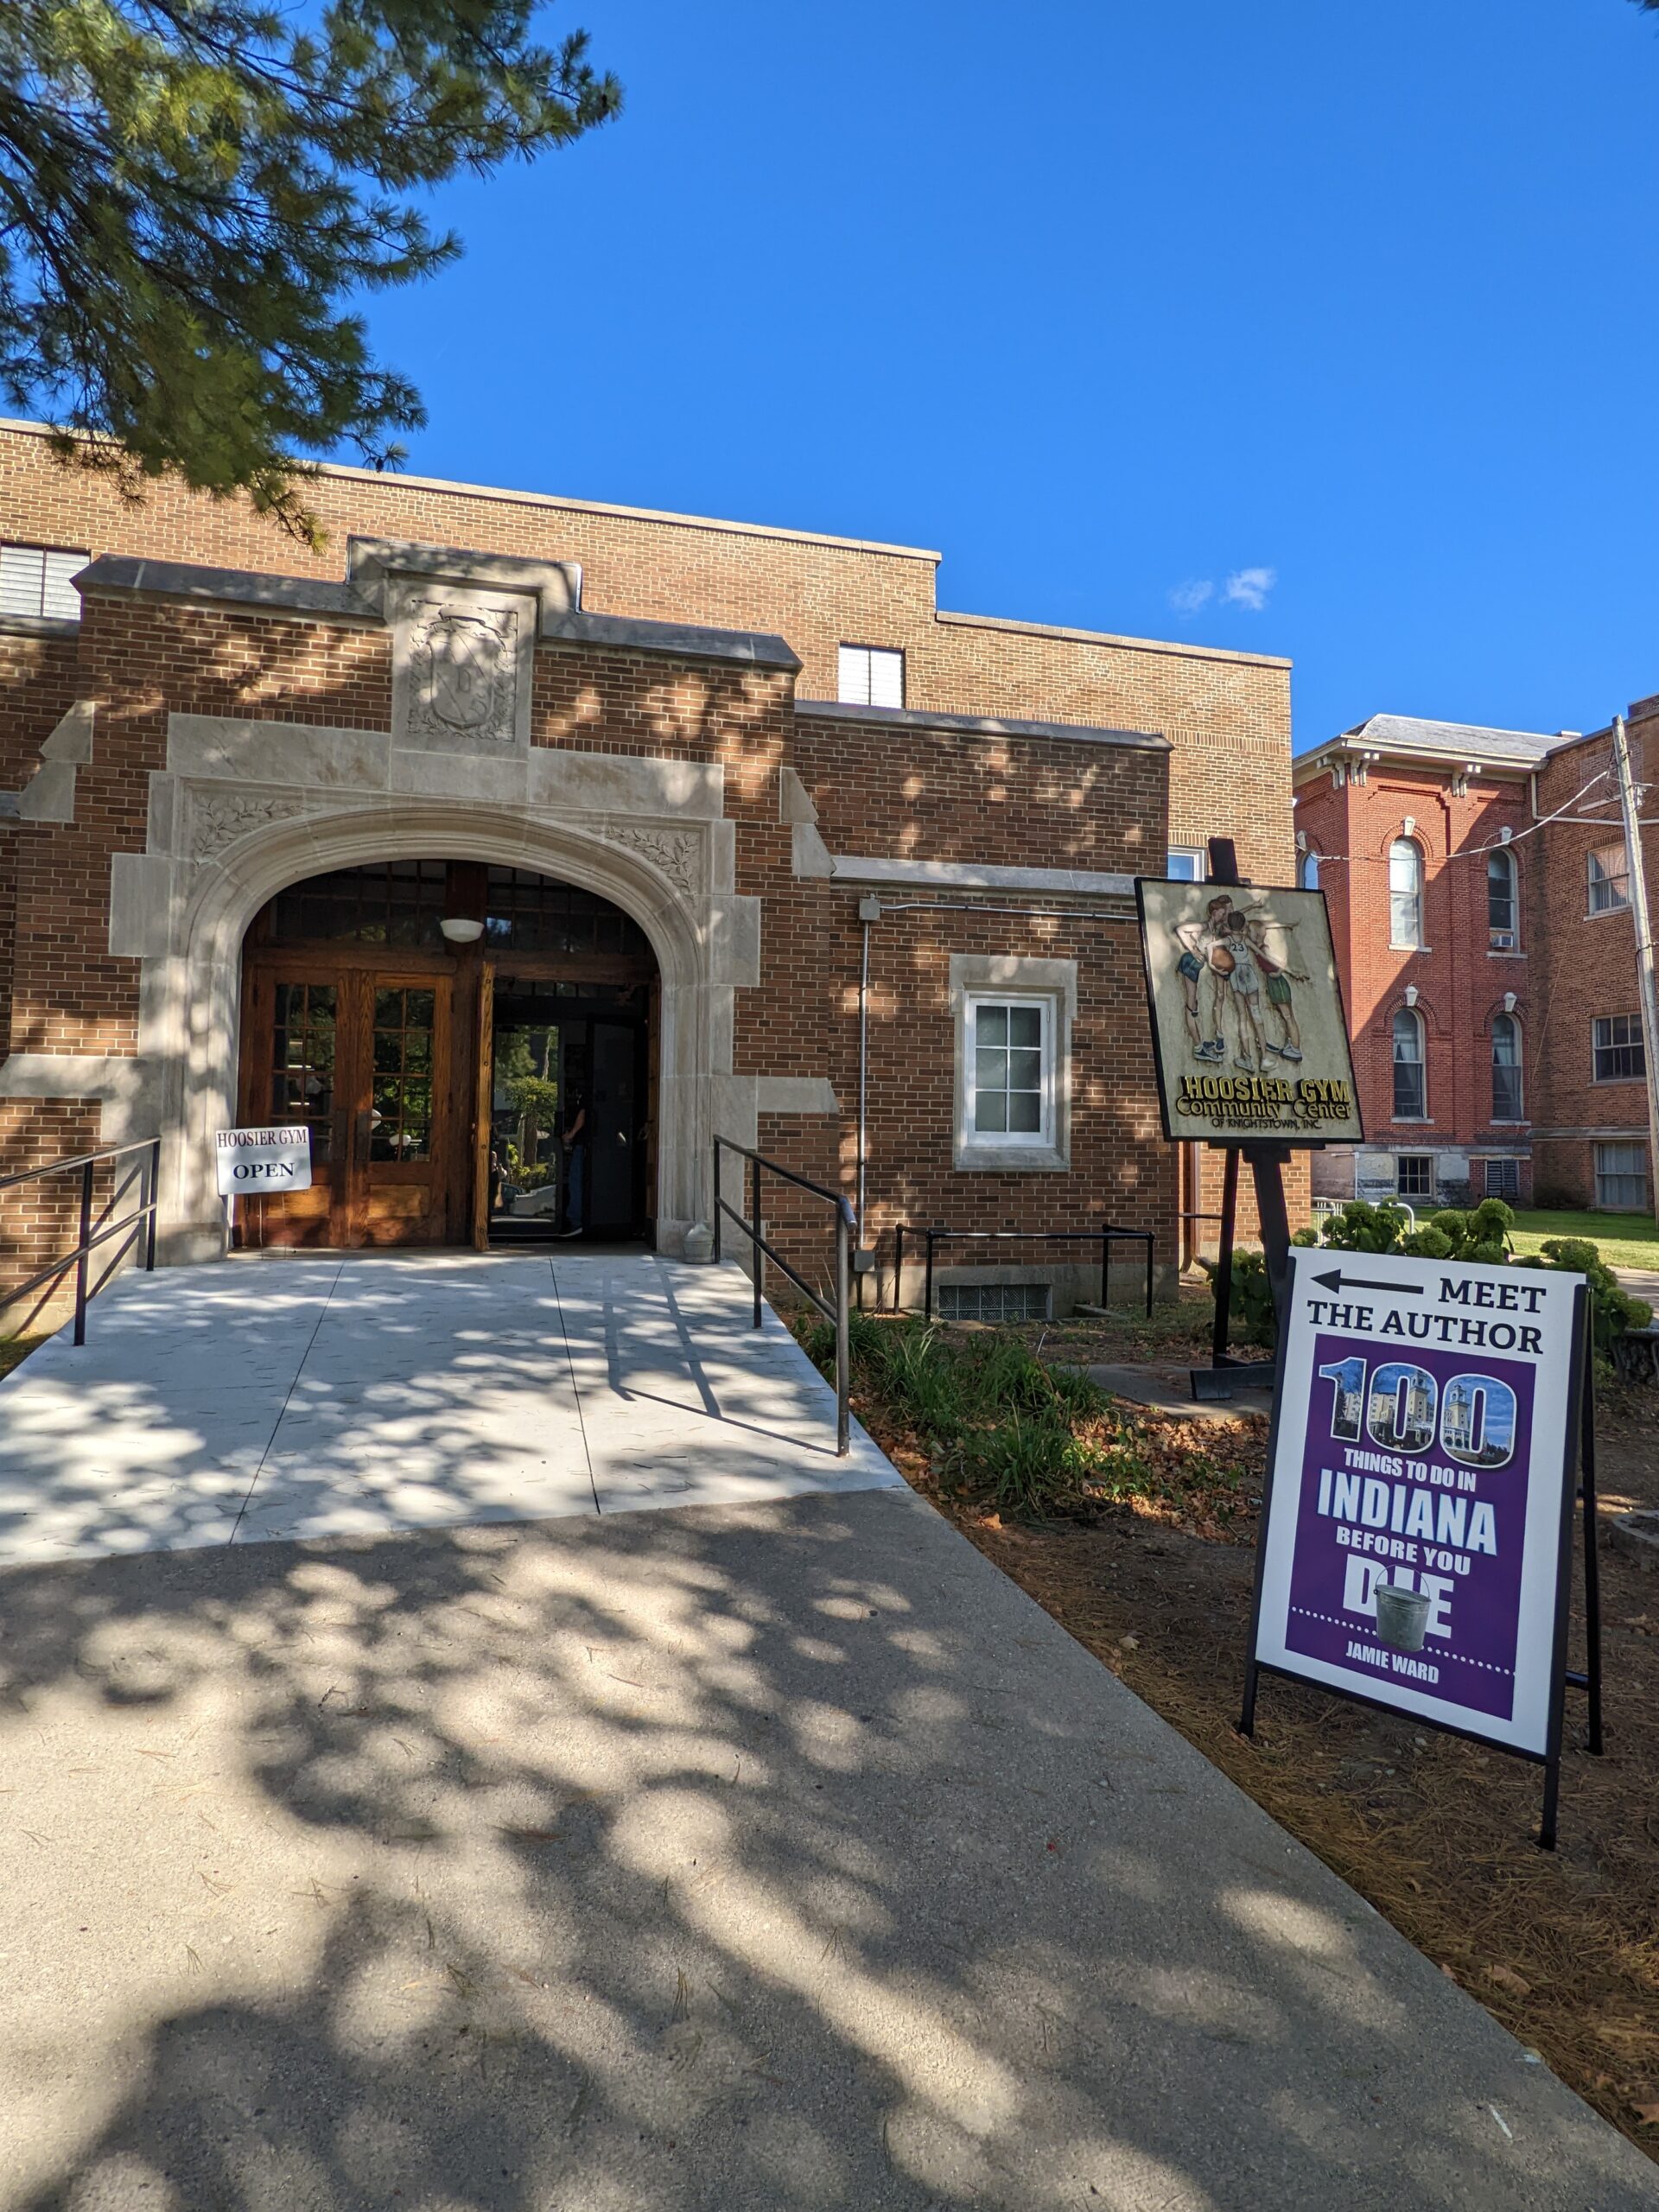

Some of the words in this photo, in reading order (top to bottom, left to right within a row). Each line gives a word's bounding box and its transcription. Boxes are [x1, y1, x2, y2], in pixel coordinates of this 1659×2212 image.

[1231, 943, 1244, 952] 23
[1176, 1096, 1280, 1119] Community
[1294, 1098, 1351, 1120] Center
[1181, 1077, 1294, 1102] HOOSIER
[1300, 1078, 1351, 1103] GYM
[218, 1131, 276, 1147] HOOSIER
[279, 1129, 307, 1144] GYM
[1211, 1118, 1224, 1128] OF
[1228, 1118, 1300, 1129] KNIGHTSTOWN,
[1302, 1119, 1323, 1129] INC.
[233, 1163, 295, 1179] OPEN
[1438, 1277, 1547, 1313] MEET
[1306, 1300, 1374, 1332] THE
[1379, 1310, 1543, 1354] AUTHOR
[1319, 1356, 1517, 1469] 100
[1344, 1447, 1403, 1477] THINGS
[1405, 1459, 1427, 1482] TO
[1430, 1465, 1455, 1486] DO
[1457, 1471, 1478, 1492] IN
[1317, 1468, 1497, 1556] INDIANA
[1335, 1525, 1418, 1563] BEFORE
[1422, 1546, 1471, 1576] YOU
[1345, 1640, 1389, 1668] JAMIE
[1392, 1653, 1440, 1685] WARD
